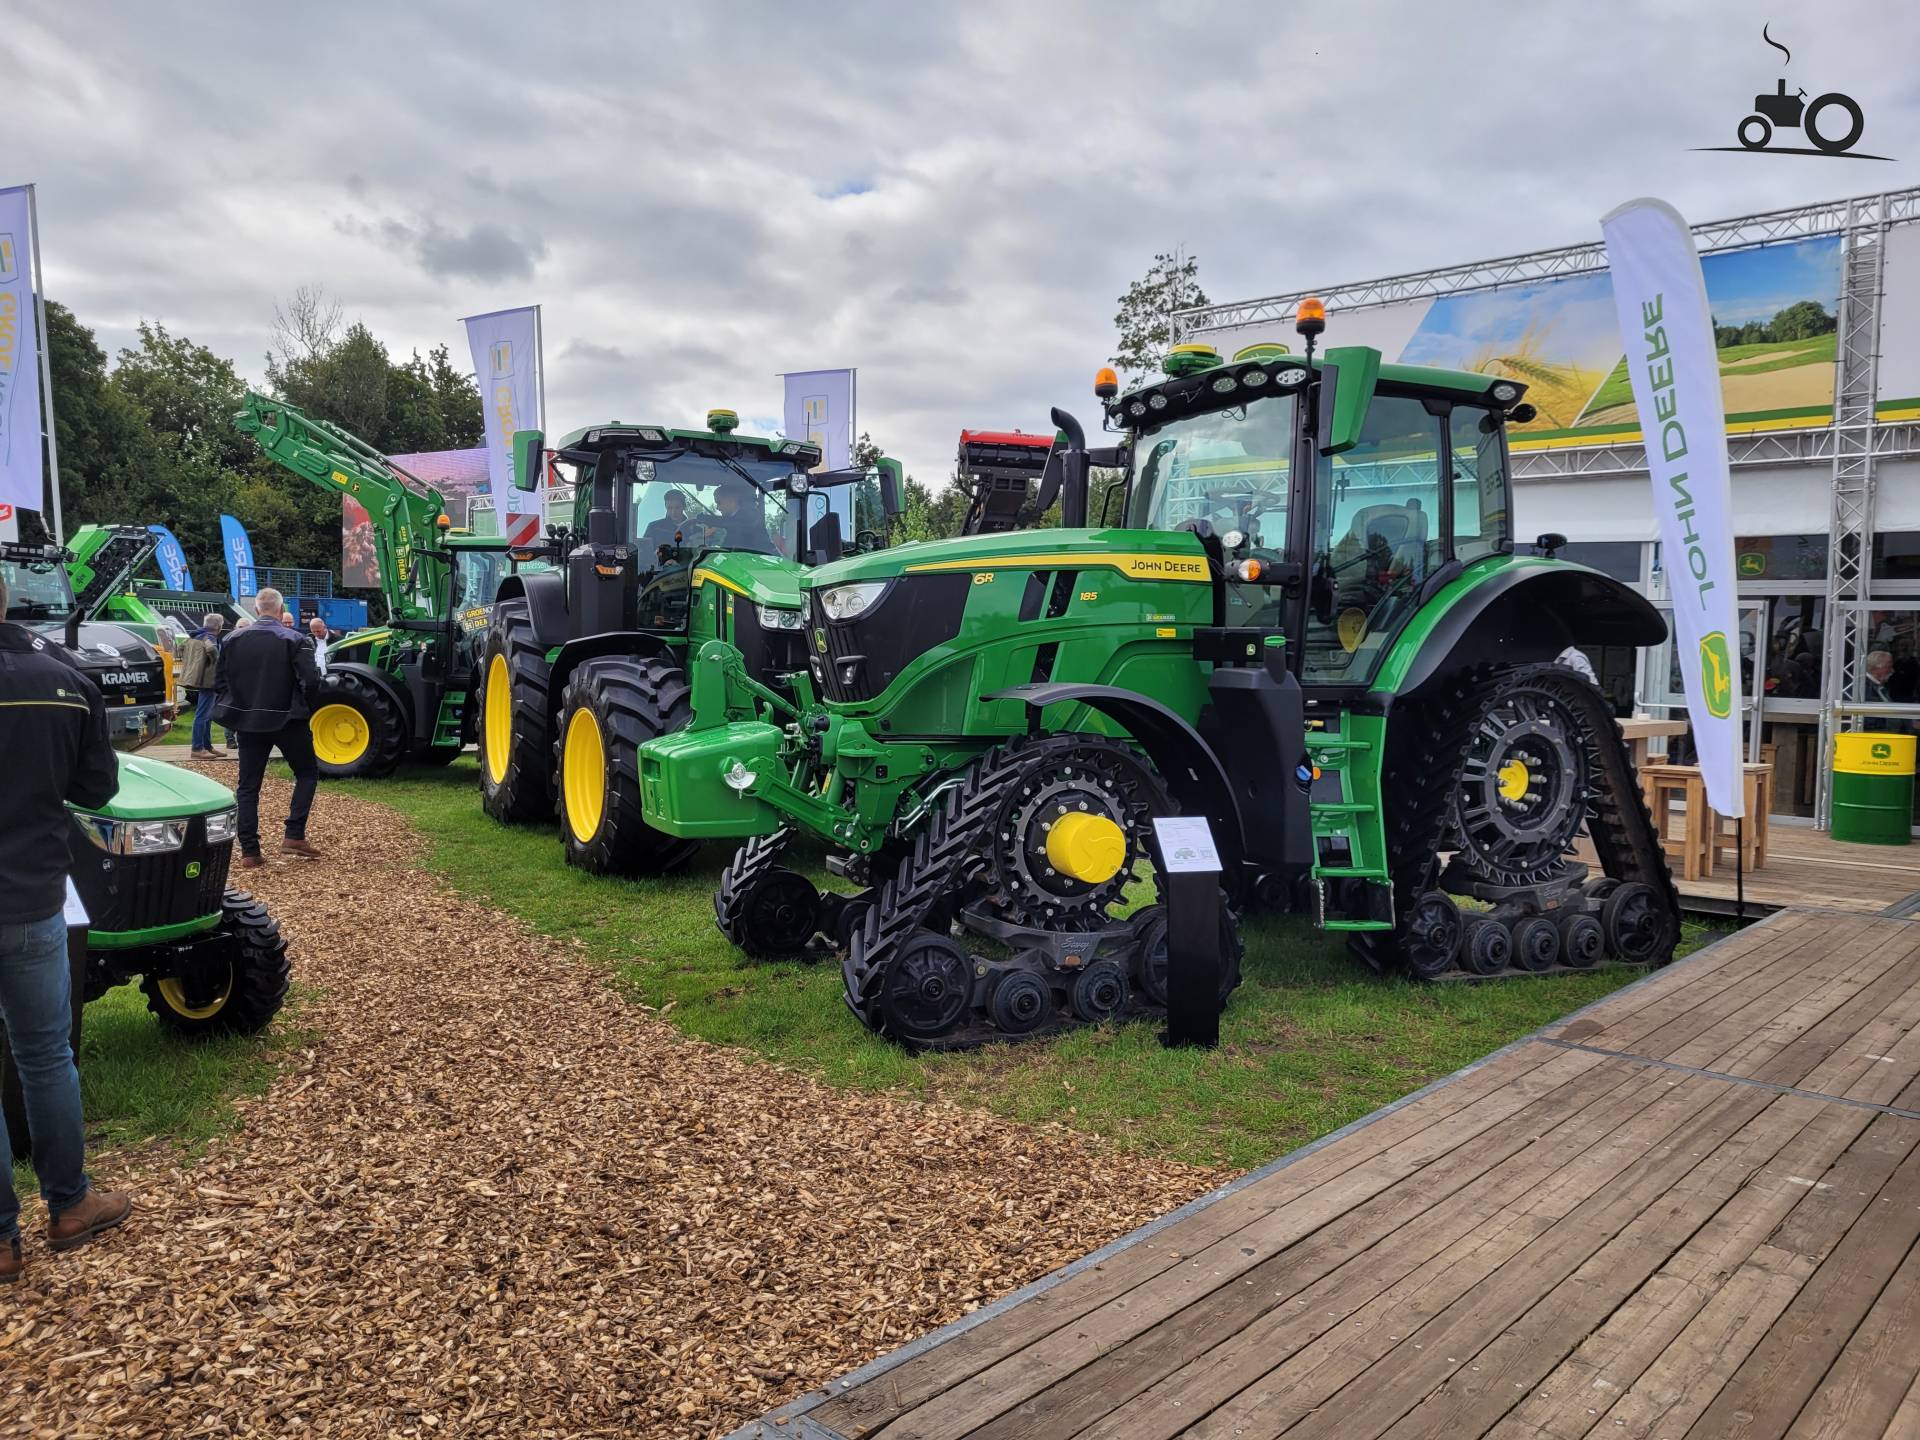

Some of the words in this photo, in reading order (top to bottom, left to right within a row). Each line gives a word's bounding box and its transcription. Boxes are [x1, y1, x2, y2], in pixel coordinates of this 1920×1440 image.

[397, 559, 407, 581] DEMO
[1131, 559, 1162, 571] JOHN
[1164, 561, 1201, 573] DEERE
[973, 573, 995, 585] 6R
[1080, 592, 1098, 601] 185
[101, 671, 150, 685] KRAMER
